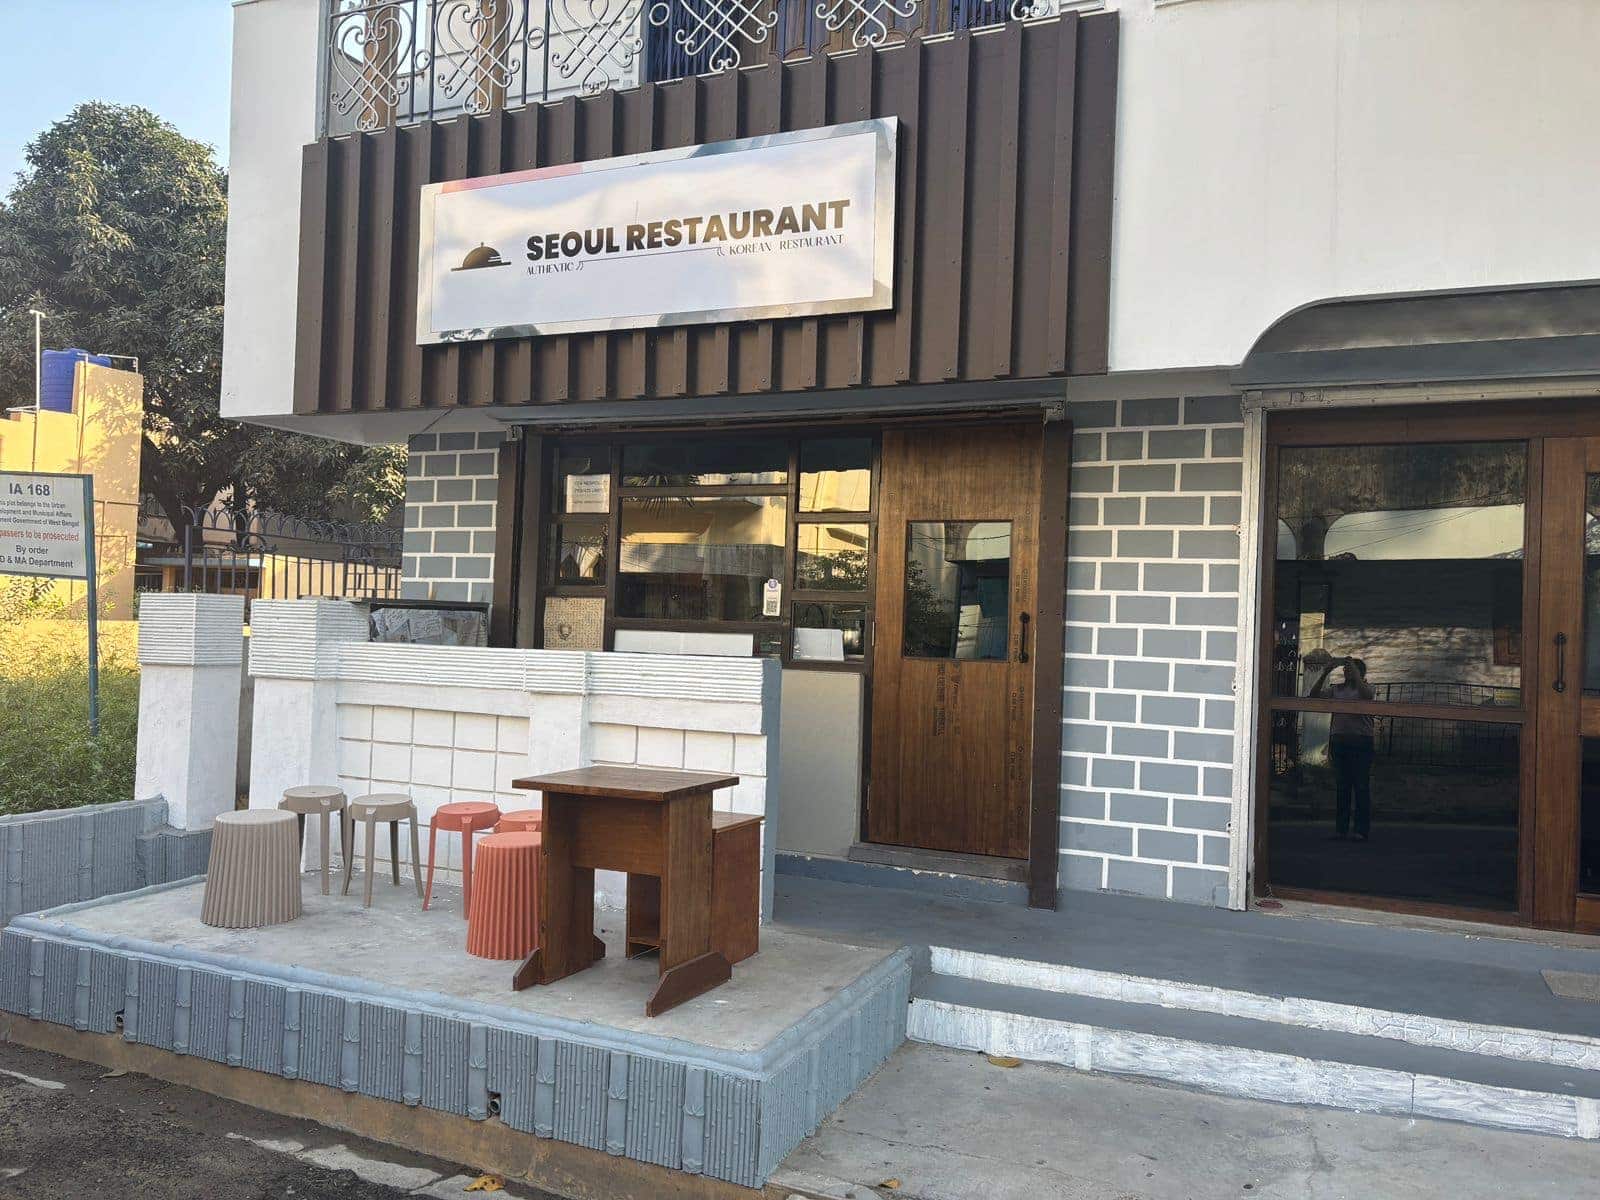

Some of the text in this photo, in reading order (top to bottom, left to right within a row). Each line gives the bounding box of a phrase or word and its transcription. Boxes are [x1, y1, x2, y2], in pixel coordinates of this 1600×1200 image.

[526, 200, 850, 261] SEOUL RESTAURANT
[729, 234, 845, 256] KOREAN RESTAURANT
[526, 262, 575, 276] AUTHENTIC
[9, 483, 51, 497] IA 168
[16, 500, 36, 508] belongs
[33, 509, 55, 517] Municipal
[12, 517, 42, 525] Government
[61, 519, 80, 528] Bengal
[25, 530, 32, 538] to
[33, 530, 41, 539] be
[42, 532, 79, 541] prosecuted
[16, 545, 48, 555] By order
[14, 556, 28, 565] MA
[28, 556, 74, 568] Department
